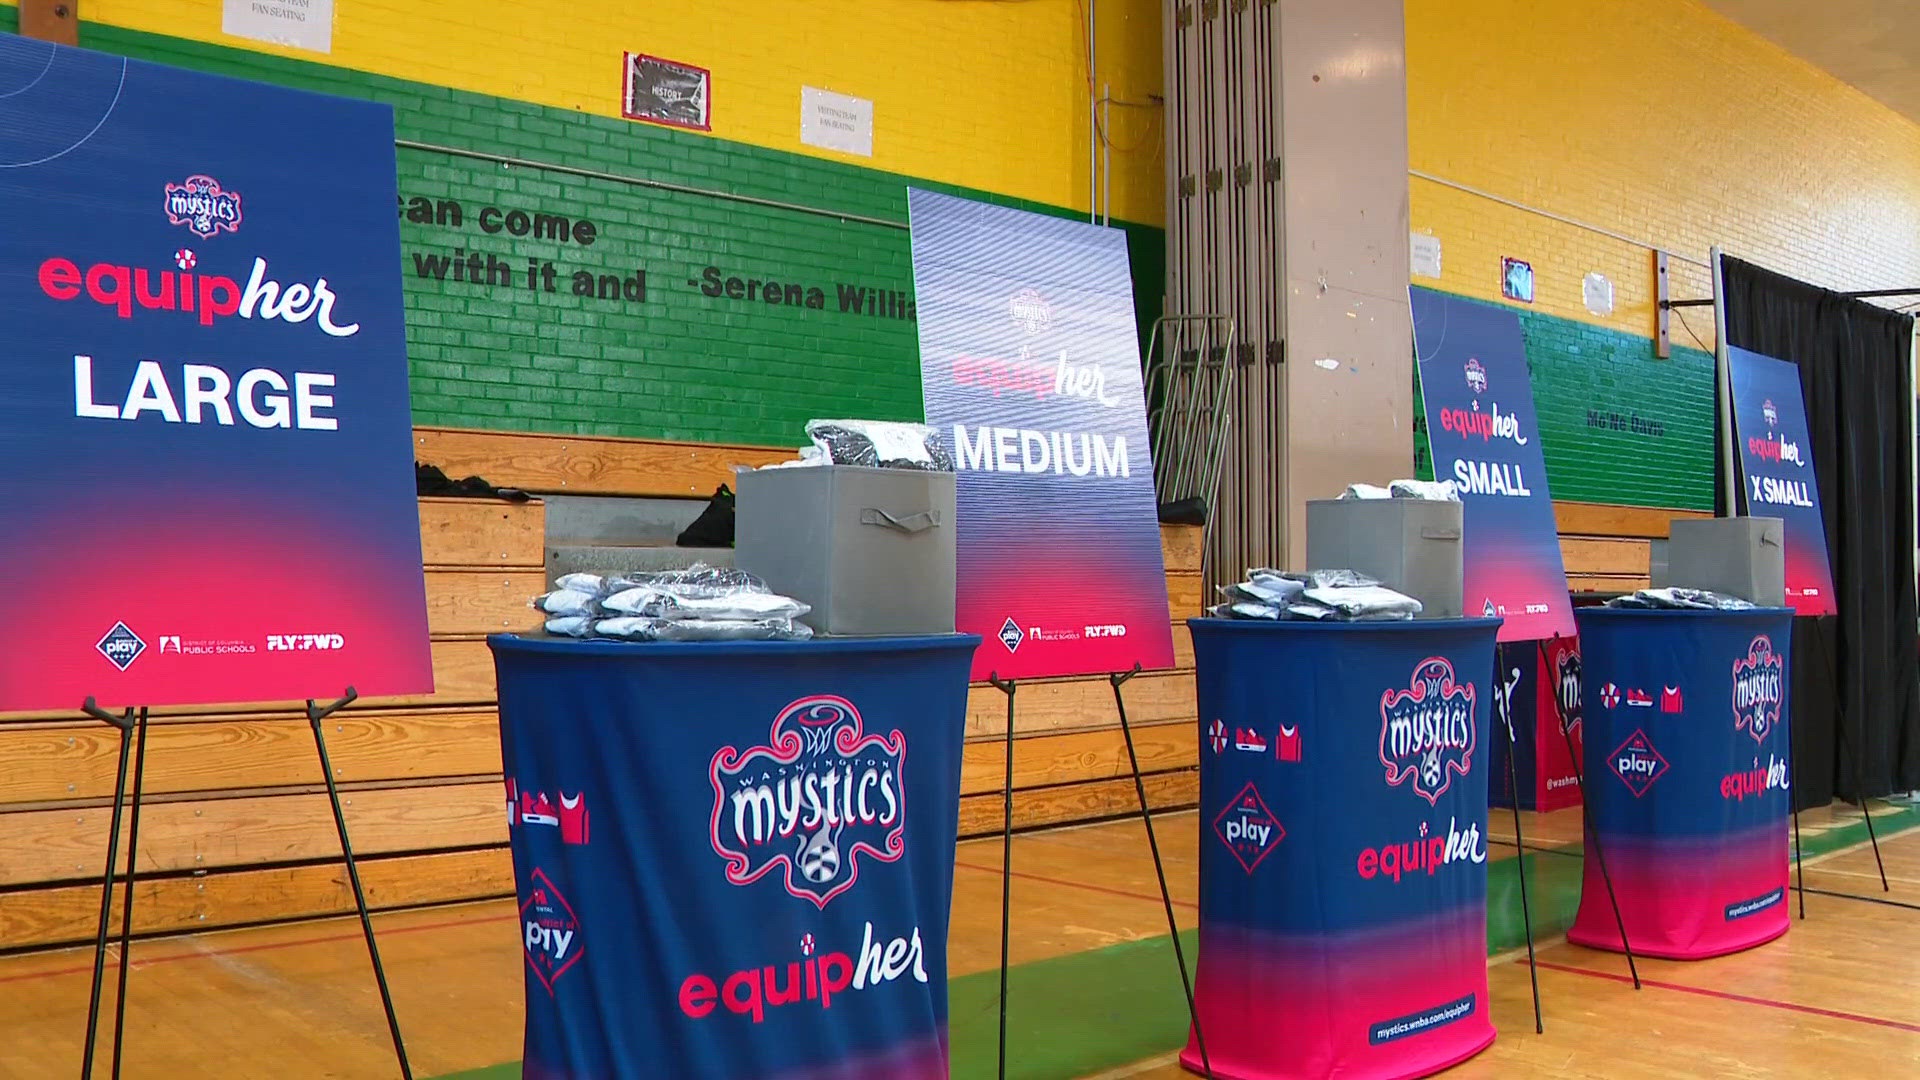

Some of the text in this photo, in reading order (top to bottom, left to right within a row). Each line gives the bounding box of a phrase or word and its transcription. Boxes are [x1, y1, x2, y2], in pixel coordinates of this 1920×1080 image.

[252, 3, 305, 22] FAN SEATING
[652, 86, 682, 100] HISTORY
[171, 193, 235, 221] mystics
[480, 206, 598, 246] come
[38, 248, 359, 337] equipher
[413, 249, 646, 303] with it and
[687, 266, 825, 310] -Serena
[74, 355, 339, 431] LARGE
[952, 344, 1120, 408] equipher
[1440, 400, 1528, 445] equipher
[1631, 413, 1665, 437] Davis
[953, 424, 1130, 479] MEDIUM
[1454, 459, 1531, 497] SMALL
[1750, 475, 1813, 507] X SMALL
[106, 639, 138, 655] play
[183, 645, 256, 655] PUBLIC SCHOOLS
[1737, 672, 1779, 709] mystics
[1390, 707, 1468, 759] mystics
[739, 759, 890, 788] WASHINGTON
[1619, 753, 1656, 776] play
[731, 765, 897, 848] mystics
[1227, 816, 1271, 847] play
[1357, 816, 1487, 884] equipher
[678, 921, 929, 1024] equipher
